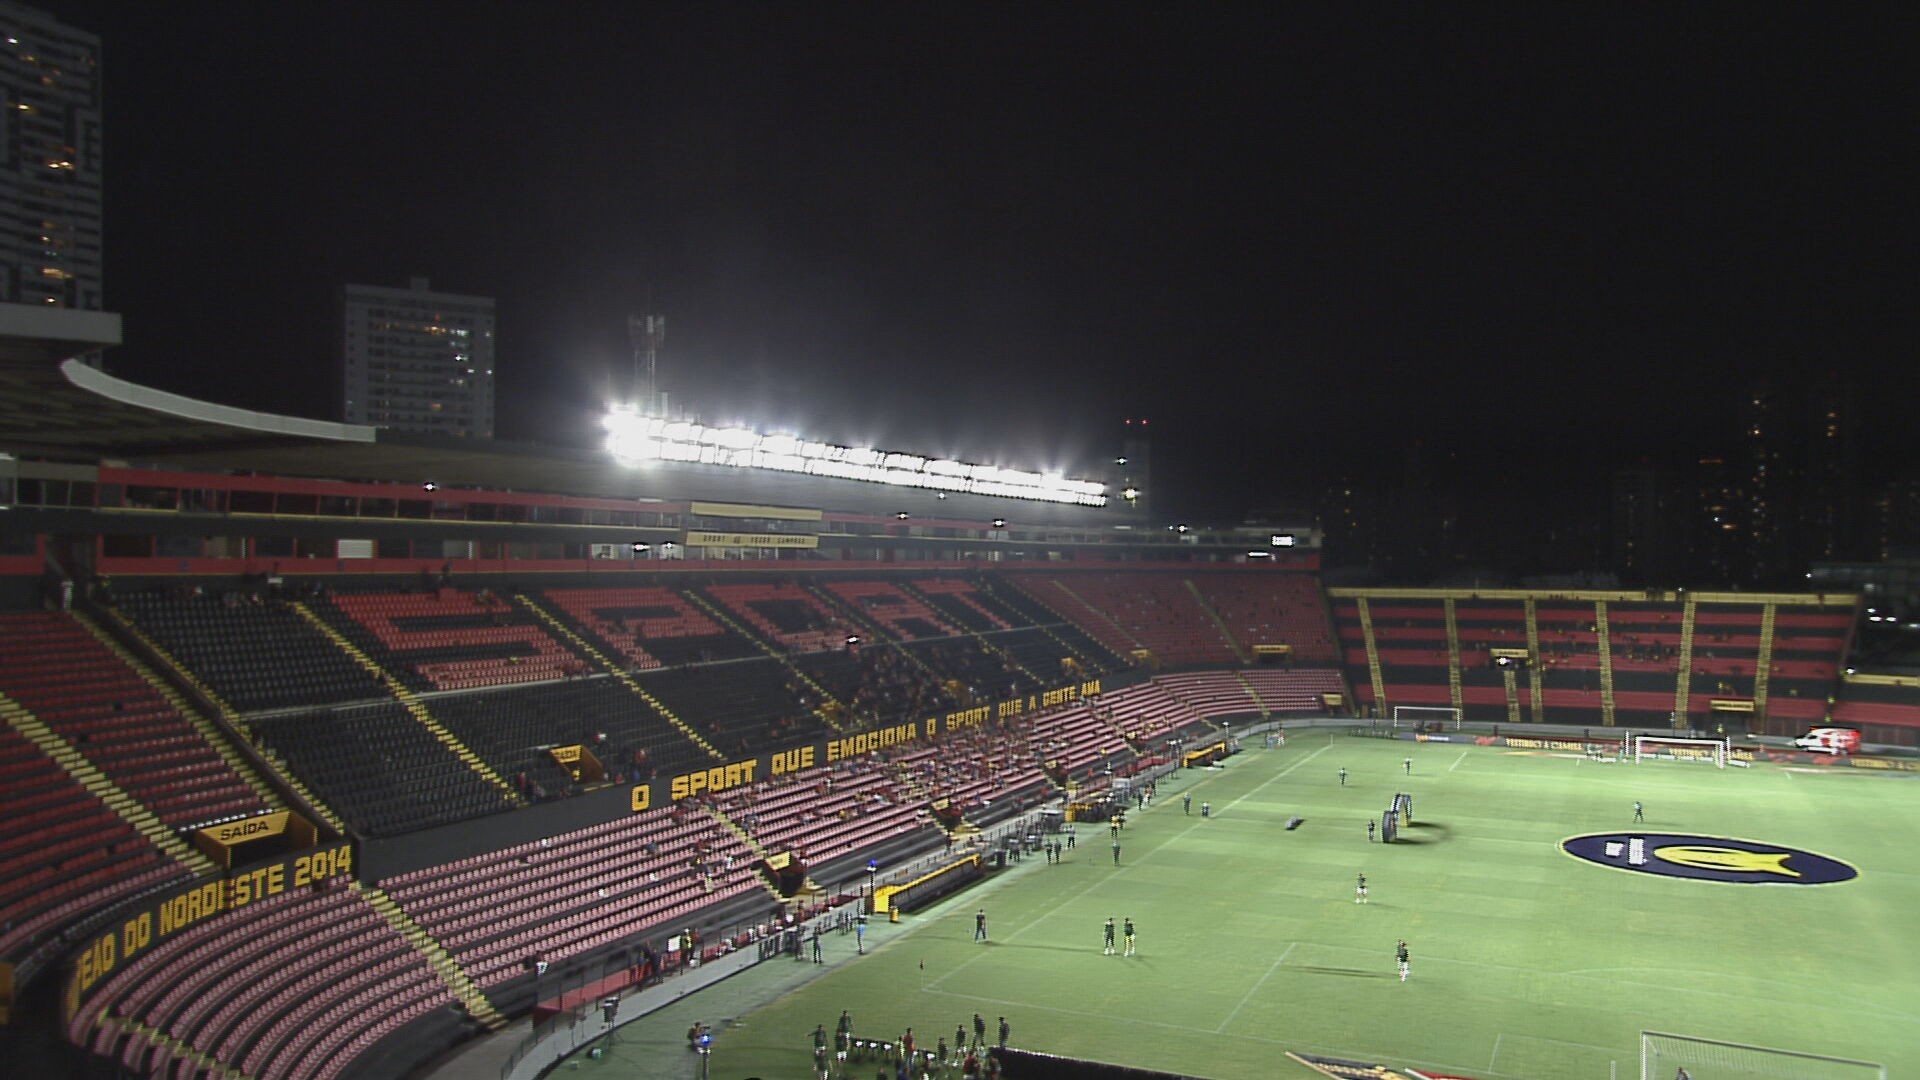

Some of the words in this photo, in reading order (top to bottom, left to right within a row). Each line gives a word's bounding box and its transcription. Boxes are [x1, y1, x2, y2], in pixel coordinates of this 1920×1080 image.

[631, 784, 649, 812] O
[671, 758, 757, 801] SPORT
[772, 745, 815, 776] QUE
[827, 722, 917, 762] EMOCIONA
[926, 718, 937, 736] O
[946, 705, 991, 731] SPORT
[998, 699, 1022, 718] QUE
[1028, 695, 1037, 711] A
[1042, 685, 1076, 707] GENTE
[220, 820, 269, 840] SAÍDA
[124, 911, 151, 959] DO
[160, 863, 285, 937] NORDESTE
[294, 845, 351, 887] 2014
